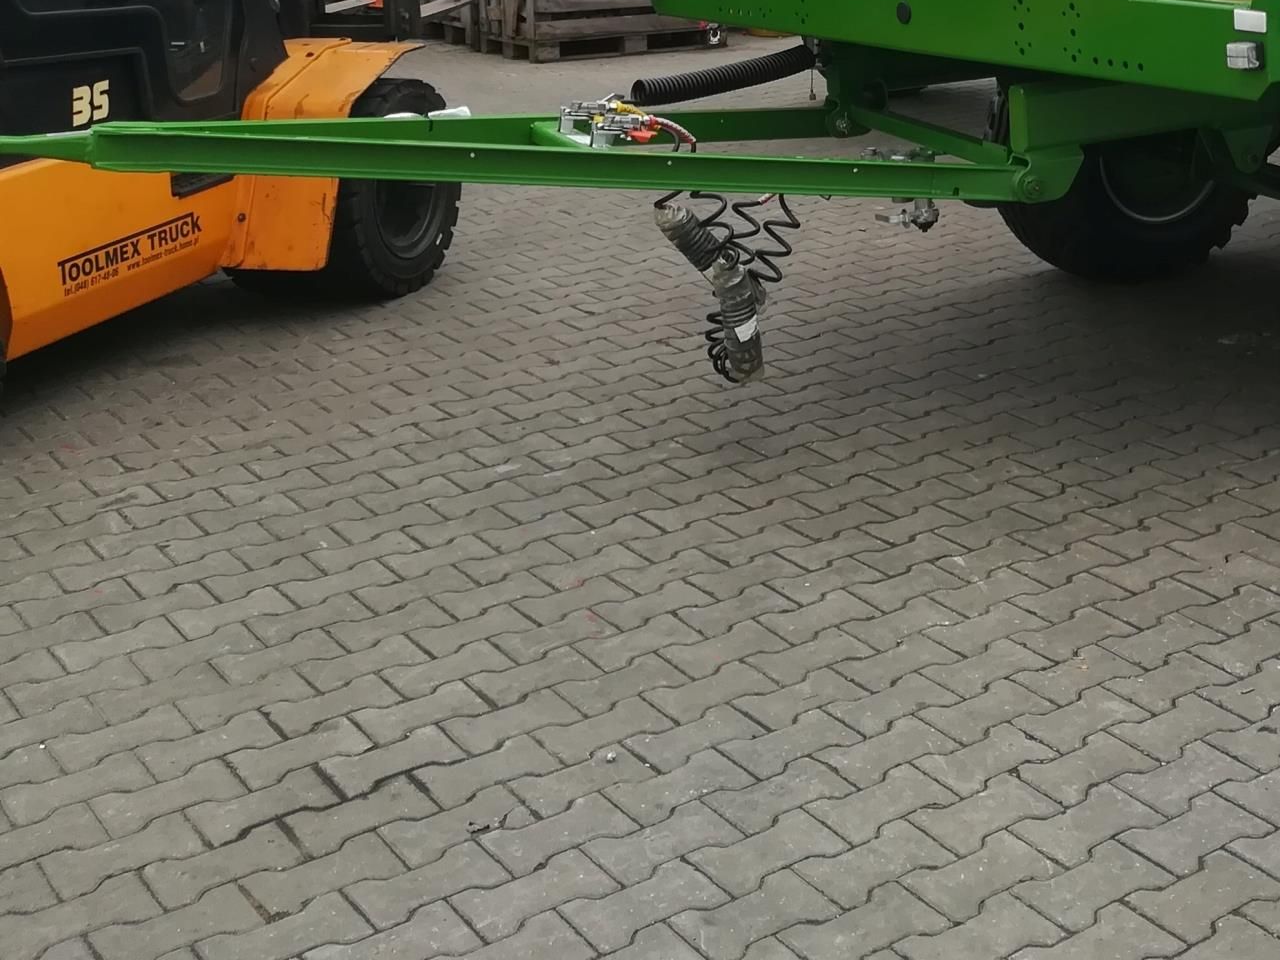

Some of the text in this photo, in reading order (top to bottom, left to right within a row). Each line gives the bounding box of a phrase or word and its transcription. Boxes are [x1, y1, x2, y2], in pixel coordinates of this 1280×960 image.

[73, 79, 109, 127] 35
[57, 211, 202, 287] TOOLMEX TRUCK
